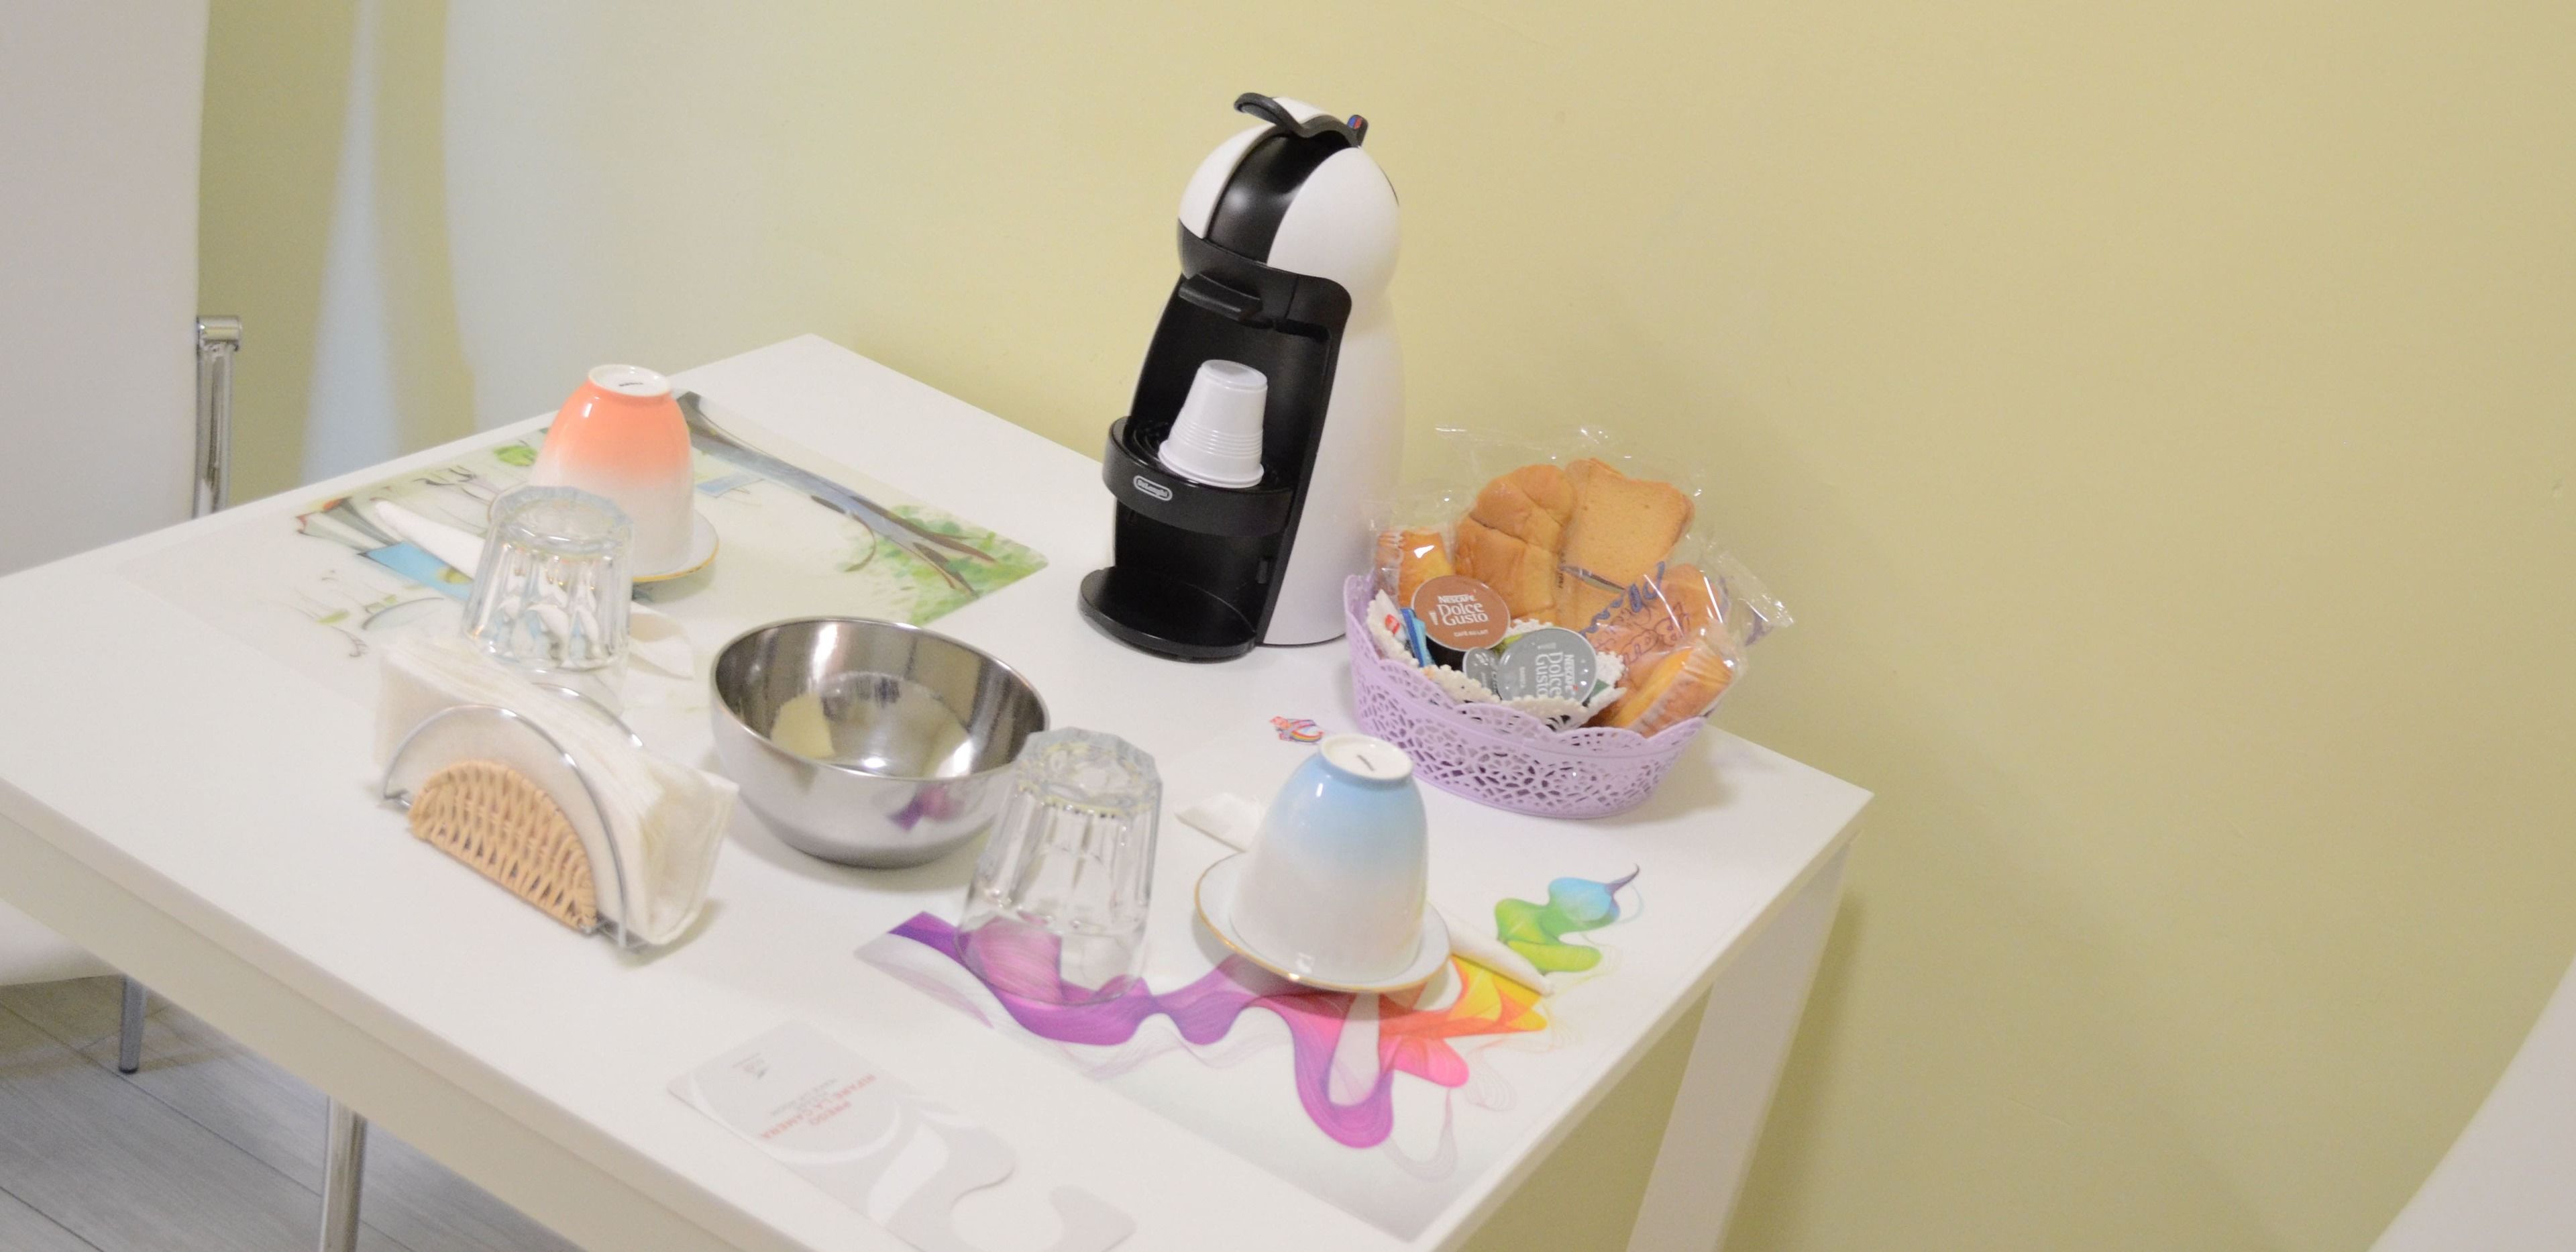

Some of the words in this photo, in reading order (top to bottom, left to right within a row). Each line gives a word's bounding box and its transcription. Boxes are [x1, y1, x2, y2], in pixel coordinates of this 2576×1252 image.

[1437, 603, 1485, 617] Dolce
[1442, 613, 1489, 626] Gusto
[1536, 654, 1549, 696] Gusto
[1548, 652, 1563, 696] Dolce
[761, 1109, 814, 1139] CAMERA
